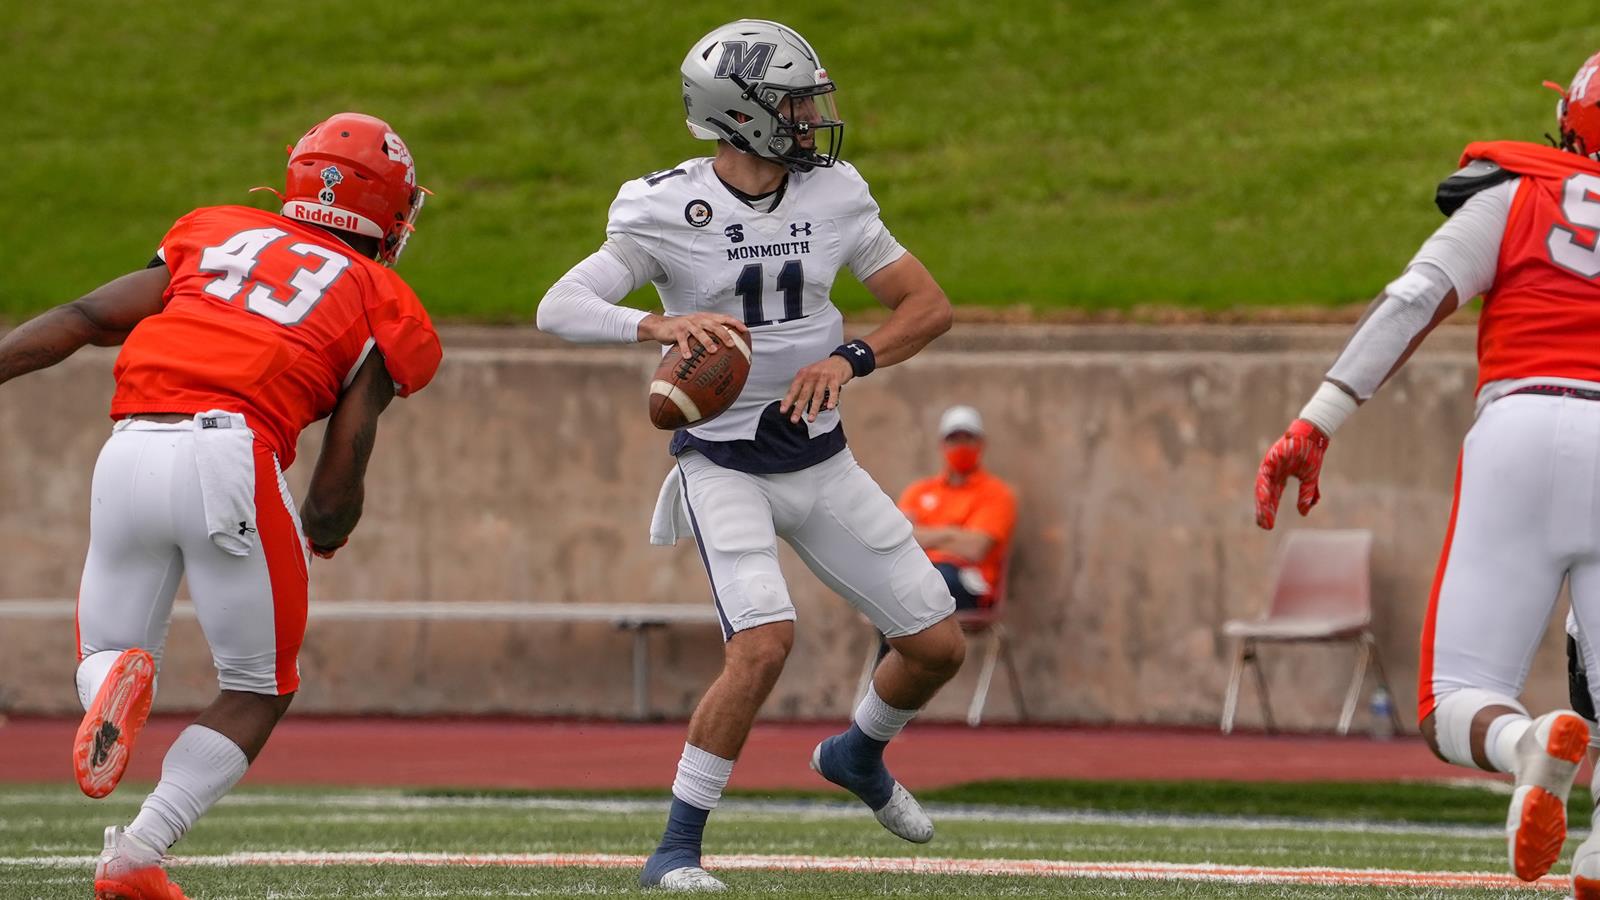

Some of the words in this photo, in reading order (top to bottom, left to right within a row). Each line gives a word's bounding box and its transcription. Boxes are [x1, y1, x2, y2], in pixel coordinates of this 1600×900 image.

[714, 41, 777, 80] M
[321, 191, 334, 202] 43
[295, 204, 359, 230] Riddell
[727, 240, 810, 261] MONMOUTH
[199, 227, 352, 326] 43
[734, 259, 810, 328] 11
